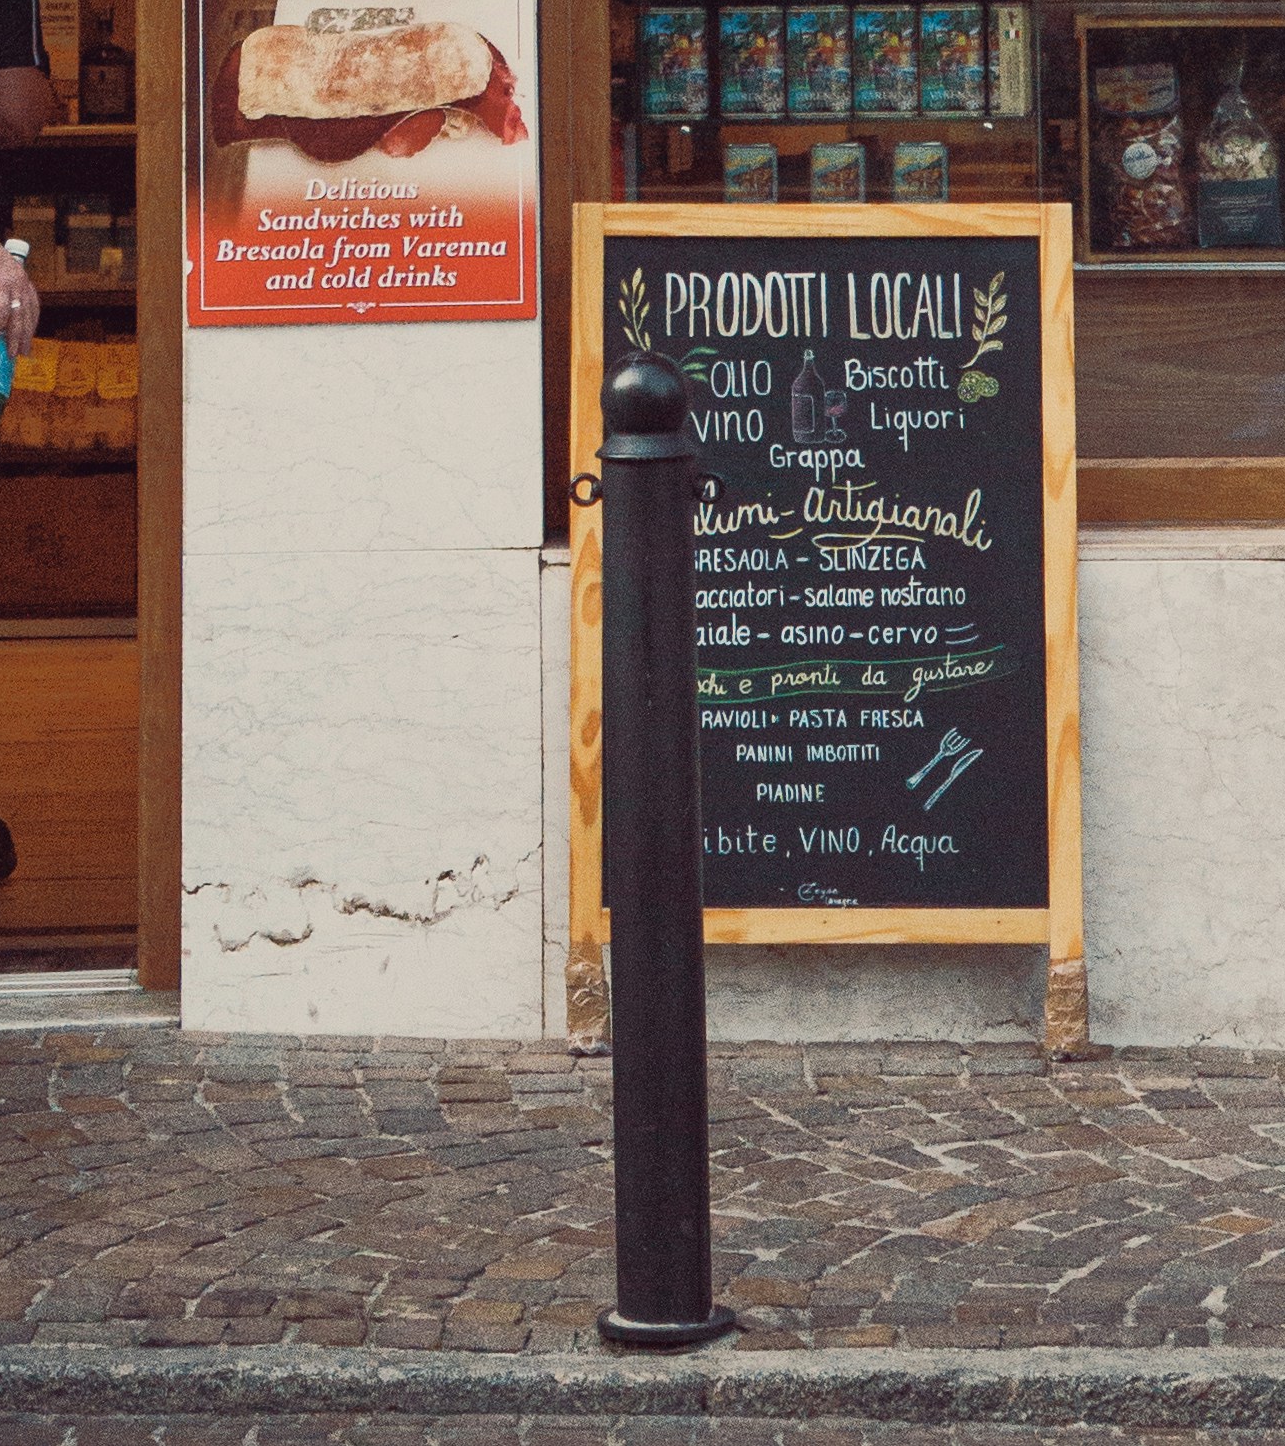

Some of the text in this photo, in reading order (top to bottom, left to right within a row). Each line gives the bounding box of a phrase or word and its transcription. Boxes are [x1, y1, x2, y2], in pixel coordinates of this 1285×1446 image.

[303, 177, 420, 202] Delicious
[257, 205, 464, 232] Sandwiches with
[216, 236, 507, 268] Bresaola from Varenna
[265, 265, 458, 292] and cold drinks
[665, 271, 962, 340] PRODOTTI LOCALI
[845, 357, 951, 392] Biscotti
[870, 403, 966, 452] Liquori
[769, 443, 866, 482] Grappa
[694, 548, 789, 572] RESAOLA
[695, 580, 785, 609] acciatori
[805, 583, 874, 608] salame
[881, 577, 967, 608] nostrano
[781, 624, 846, 646] asino
[868, 624, 939, 646] cervo
[861, 665, 887, 686] da
[701, 708, 925, 729] RAVIOLI PASTA FRESCA
[736, 743, 881, 762] PANINI IMBOTTITI
[756, 783, 826, 803] PIADINE
[880, 824, 960, 872] Acqua
